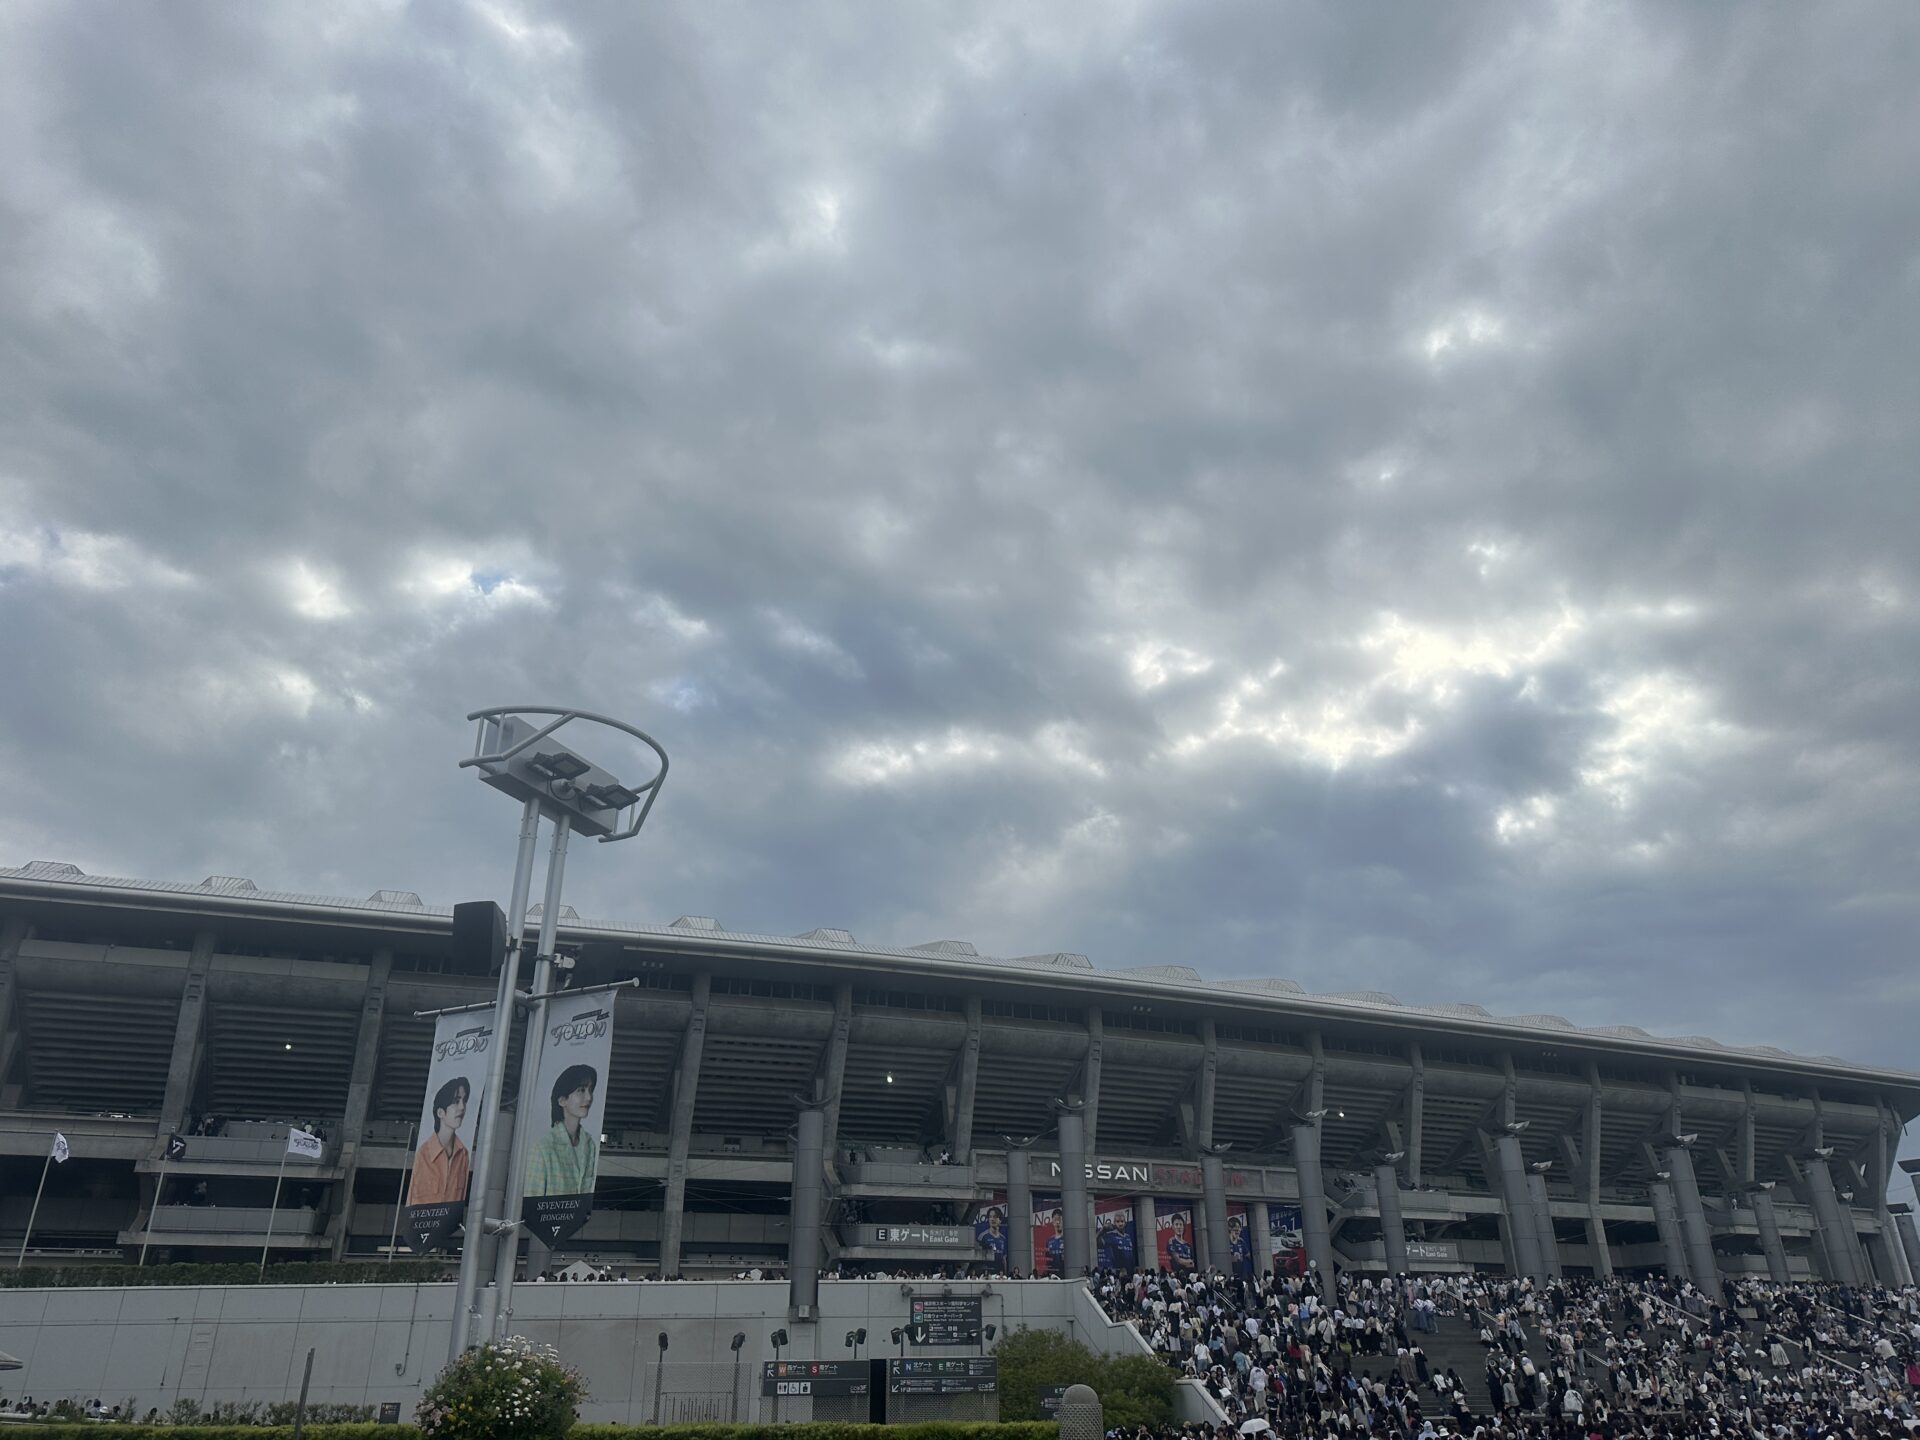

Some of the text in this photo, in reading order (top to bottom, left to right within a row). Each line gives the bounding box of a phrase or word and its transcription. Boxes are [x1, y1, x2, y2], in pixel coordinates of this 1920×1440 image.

[1051, 1162, 1148, 1182] NSSAN
[537, 1200, 580, 1211] SEVENTEEN
[410, 1208, 450, 1219] SEVENTEEN
[540, 1213, 575, 1222] JEONGHAN
[414, 1220, 440, 1229] S.COUPS
[878, 1229, 886, 1240] E
[890, 1228, 929, 1242] 東ゲート
[929, 1235, 959, 1243] East Gate
